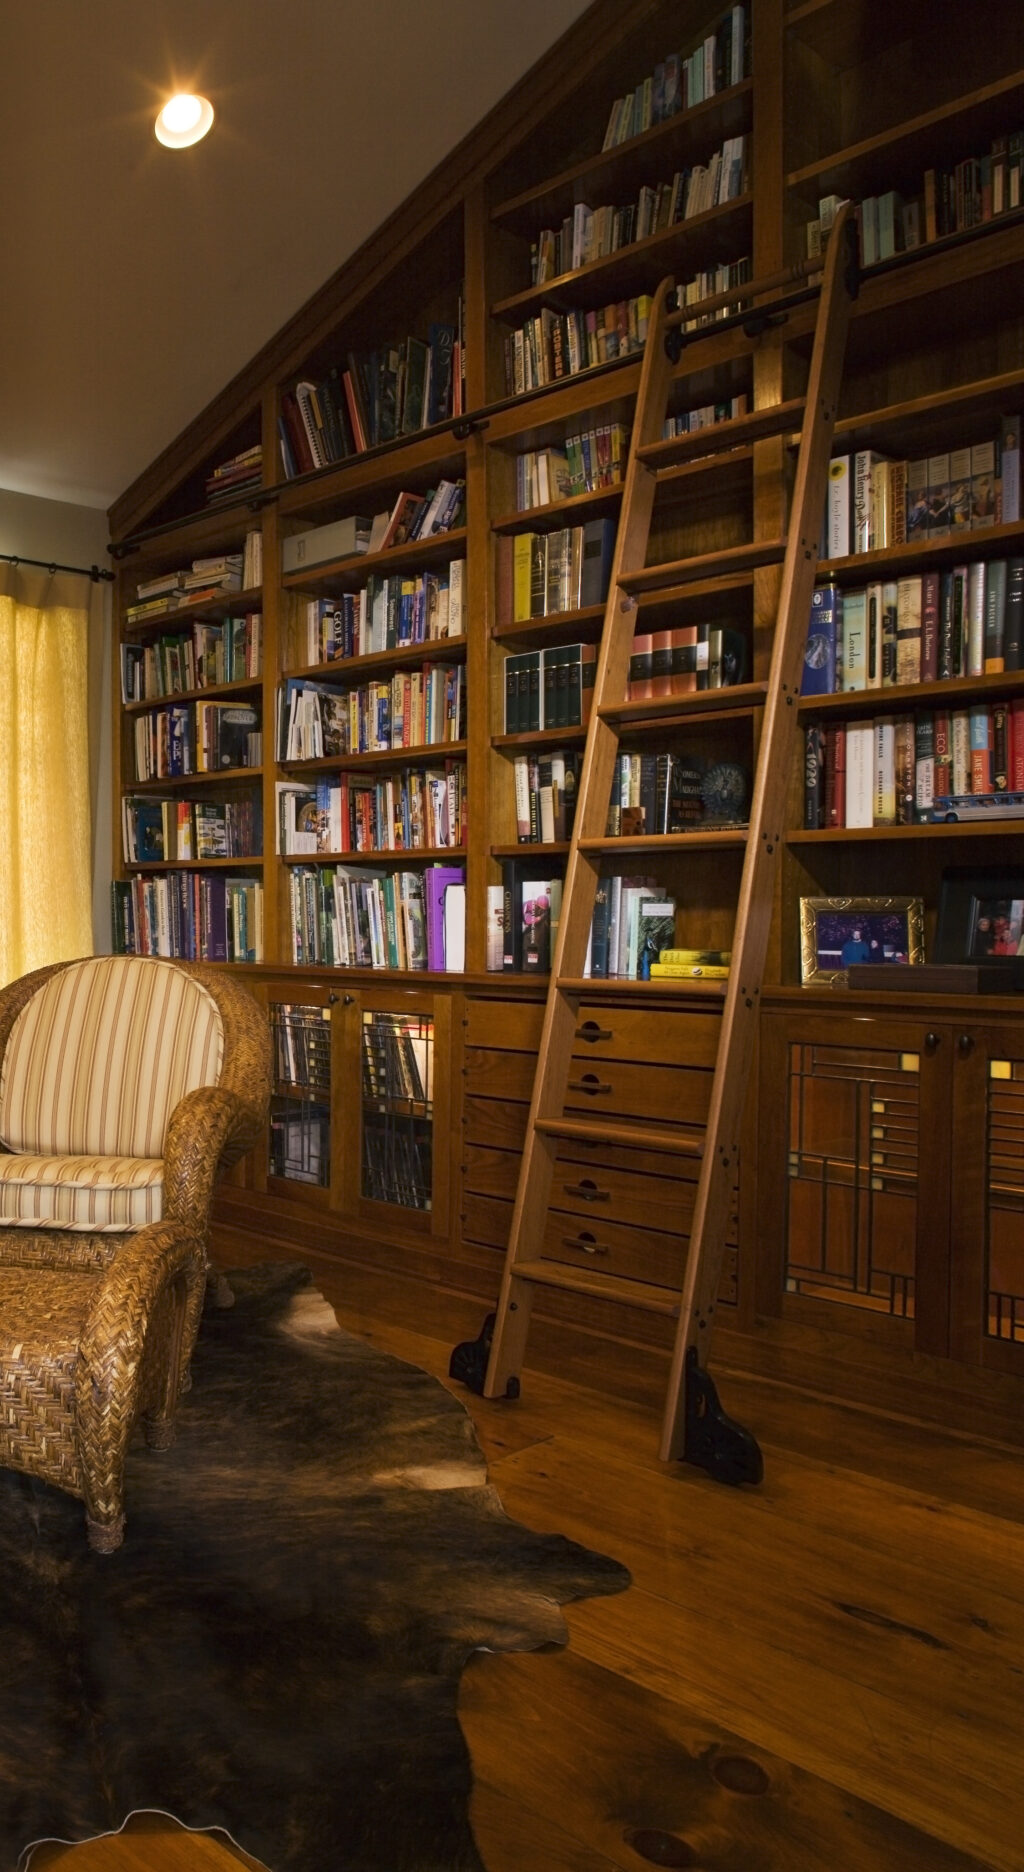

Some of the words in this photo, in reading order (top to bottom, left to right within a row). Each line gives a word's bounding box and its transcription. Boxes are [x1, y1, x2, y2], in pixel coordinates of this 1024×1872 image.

[857, 455, 866, 475] John
[855, 476, 866, 500] Henry
[333, 611, 343, 644] GOLF
[388, 598, 396, 632] Southwest
[848, 632, 862, 669] London
[936, 732, 946, 754] ECO
[806, 753, 818, 788] 1929
[973, 755, 983, 772] JANE
[973, 774, 983, 796] SMILE
[504, 891, 513, 934] CHAMPIONS
